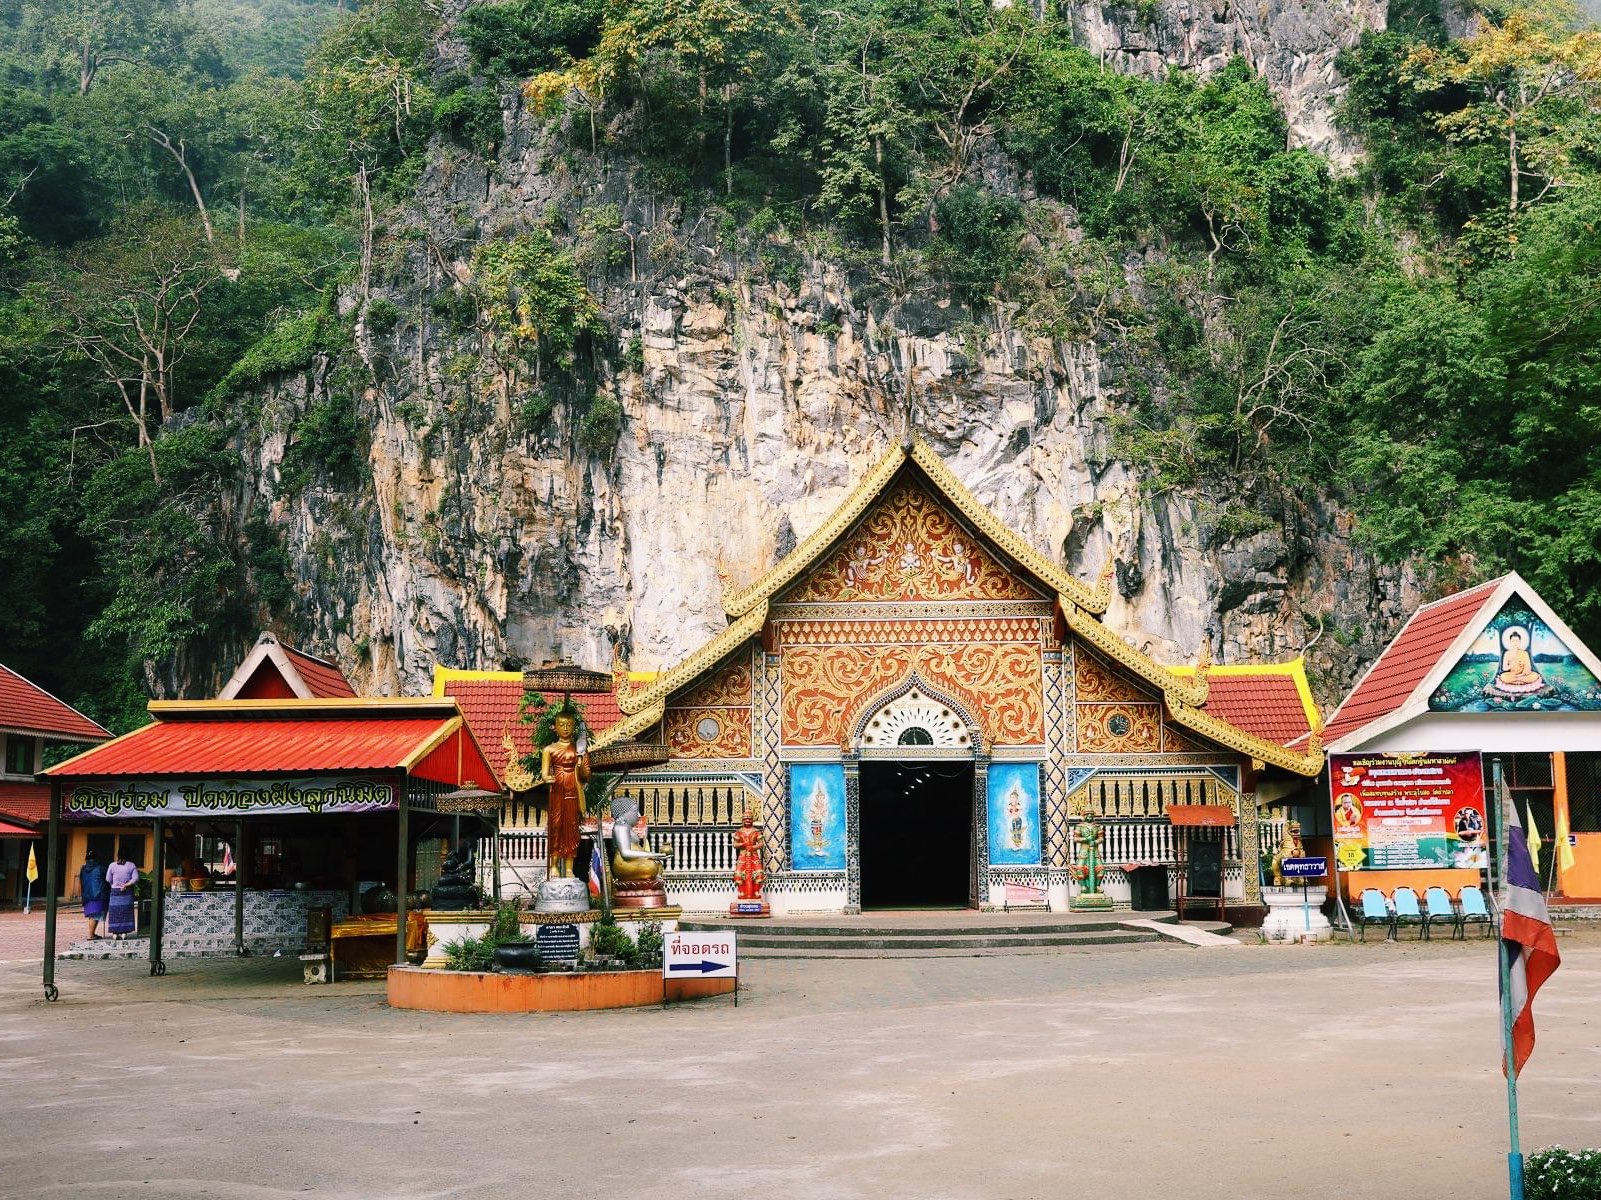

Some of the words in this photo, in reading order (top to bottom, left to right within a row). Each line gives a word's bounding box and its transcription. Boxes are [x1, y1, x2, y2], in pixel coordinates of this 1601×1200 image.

[69, 783, 170, 815] เชิญร่วม
[178, 780, 392, 814] ปิดทองฝังลูกนิมิต
[671, 935, 729, 955] ที่จอดรถ
